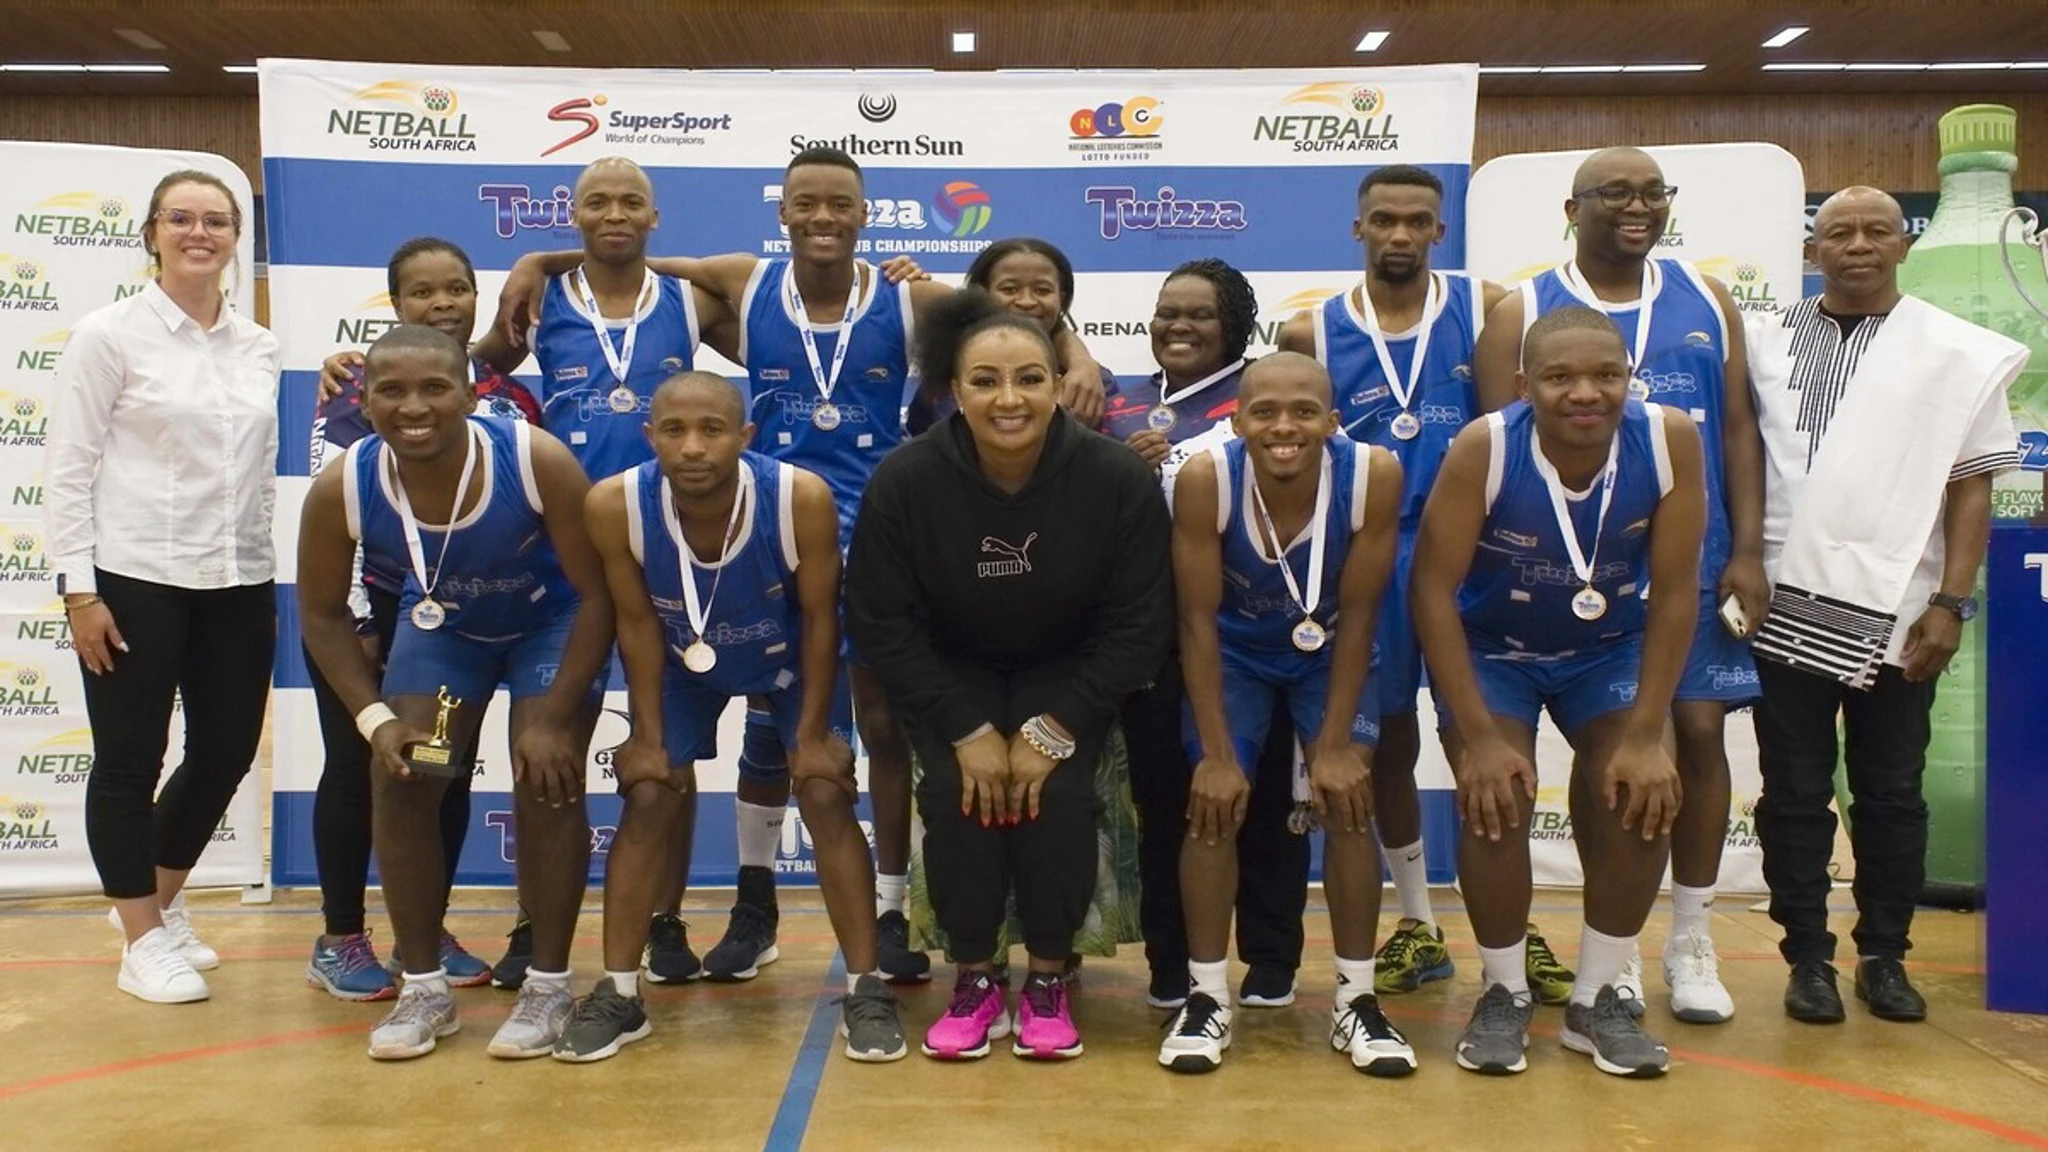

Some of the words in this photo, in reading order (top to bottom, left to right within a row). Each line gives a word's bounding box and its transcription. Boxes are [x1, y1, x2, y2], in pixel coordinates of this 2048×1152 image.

[327, 109, 477, 139] NETBALL
[608, 110, 731, 132] SuperSport
[1253, 113, 1399, 141] NETBALL
[369, 137, 422, 150] SOUTH
[423, 139, 477, 152] AFRICA
[605, 133, 634, 145] World
[636, 133, 649, 145] of
[650, 133, 705, 146] Champions
[915, 135, 964, 156] Sun
[1293, 139, 1345, 152] SOUTH
[1346, 138, 1399, 152] AFRICA
[1081, 153, 1110, 161] LOTTO
[1113, 153, 1150, 161] FUNDED
[479, 184, 573, 238] Twi
[1085, 185, 1248, 240] Twizza
[15, 214, 141, 238] NETBALL
[53, 235, 97, 247] SOUTH
[98, 237, 143, 249] AFRICA
[876, 240, 993, 253] CHAMPIONSHIPS
[14, 301, 59, 311] AFRICA
[1084, 322, 1148, 336] RENA
[10, 436, 47, 447] AFRIC
[1997, 505, 2036, 518] SOFT
[978, 559, 1023, 578] PUMA
[15, 706, 60, 716] AFRICA
[17, 753, 93, 774] NETB
[54, 773, 89, 784] SOUT
[14, 839, 59, 850] AFRICA
